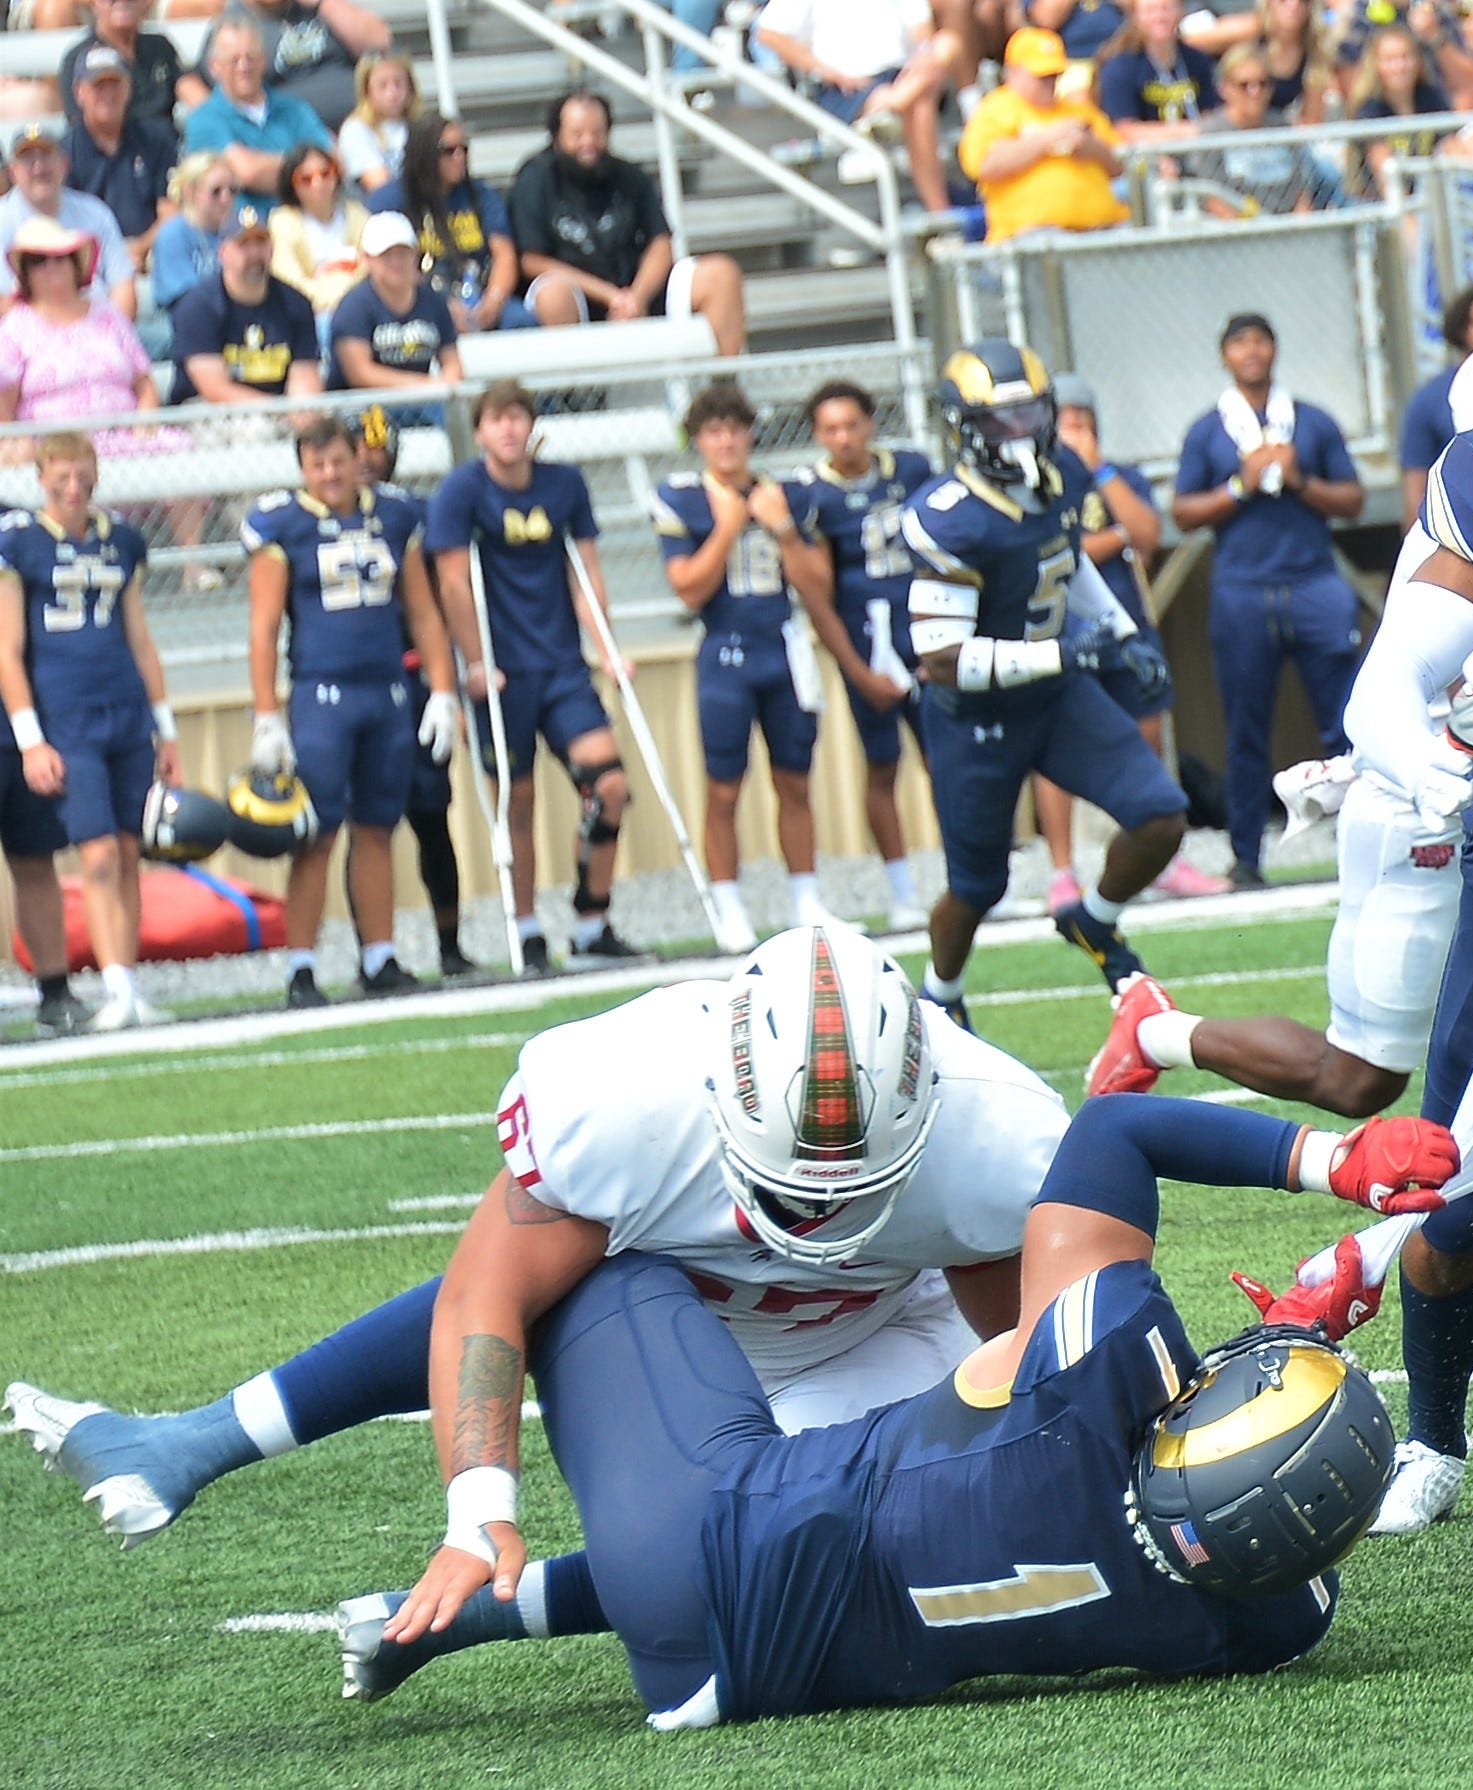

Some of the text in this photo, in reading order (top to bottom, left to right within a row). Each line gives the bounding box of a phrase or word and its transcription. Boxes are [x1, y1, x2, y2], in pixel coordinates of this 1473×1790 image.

[1022, 546, 1077, 641] 5
[728, 988, 753, 1043] THE
[800, 1165, 860, 1178] Riddell
[908, 1562, 1112, 1627] 1
